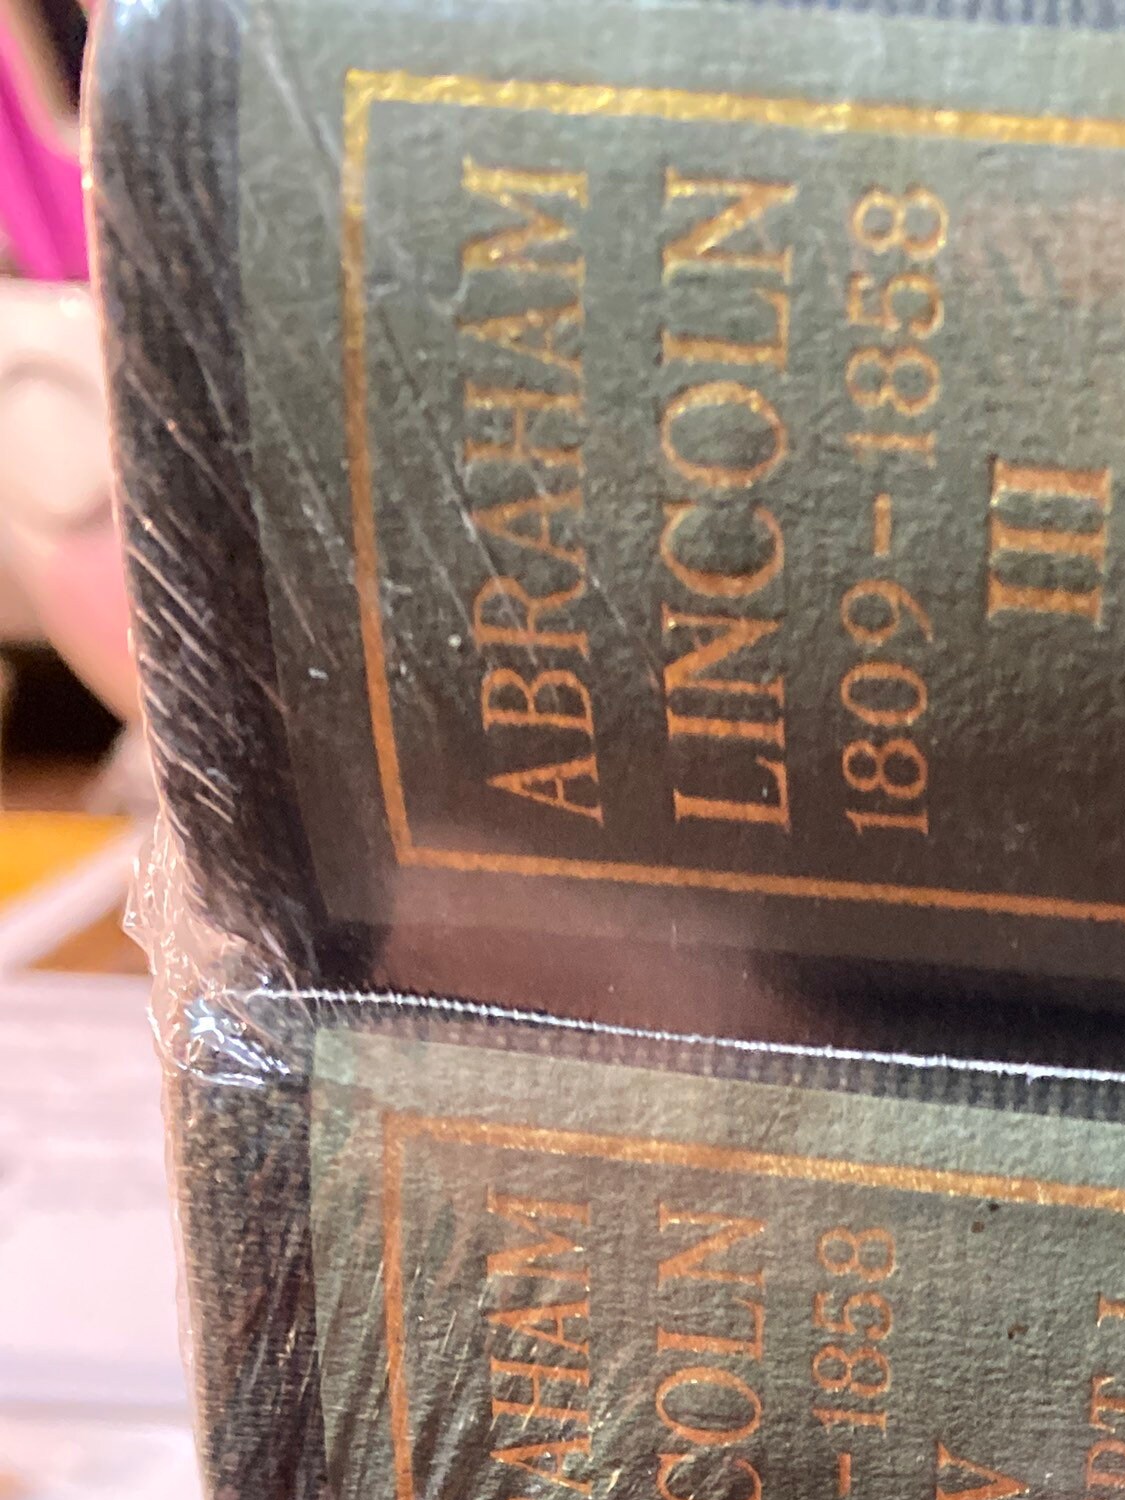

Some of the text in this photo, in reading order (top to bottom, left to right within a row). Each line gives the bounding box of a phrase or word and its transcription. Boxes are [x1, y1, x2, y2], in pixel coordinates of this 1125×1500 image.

[461, 156, 603, 828] ABRAHAM
[659, 167, 797, 832] LINCOLN
[986, 457, 1111, 627] III
